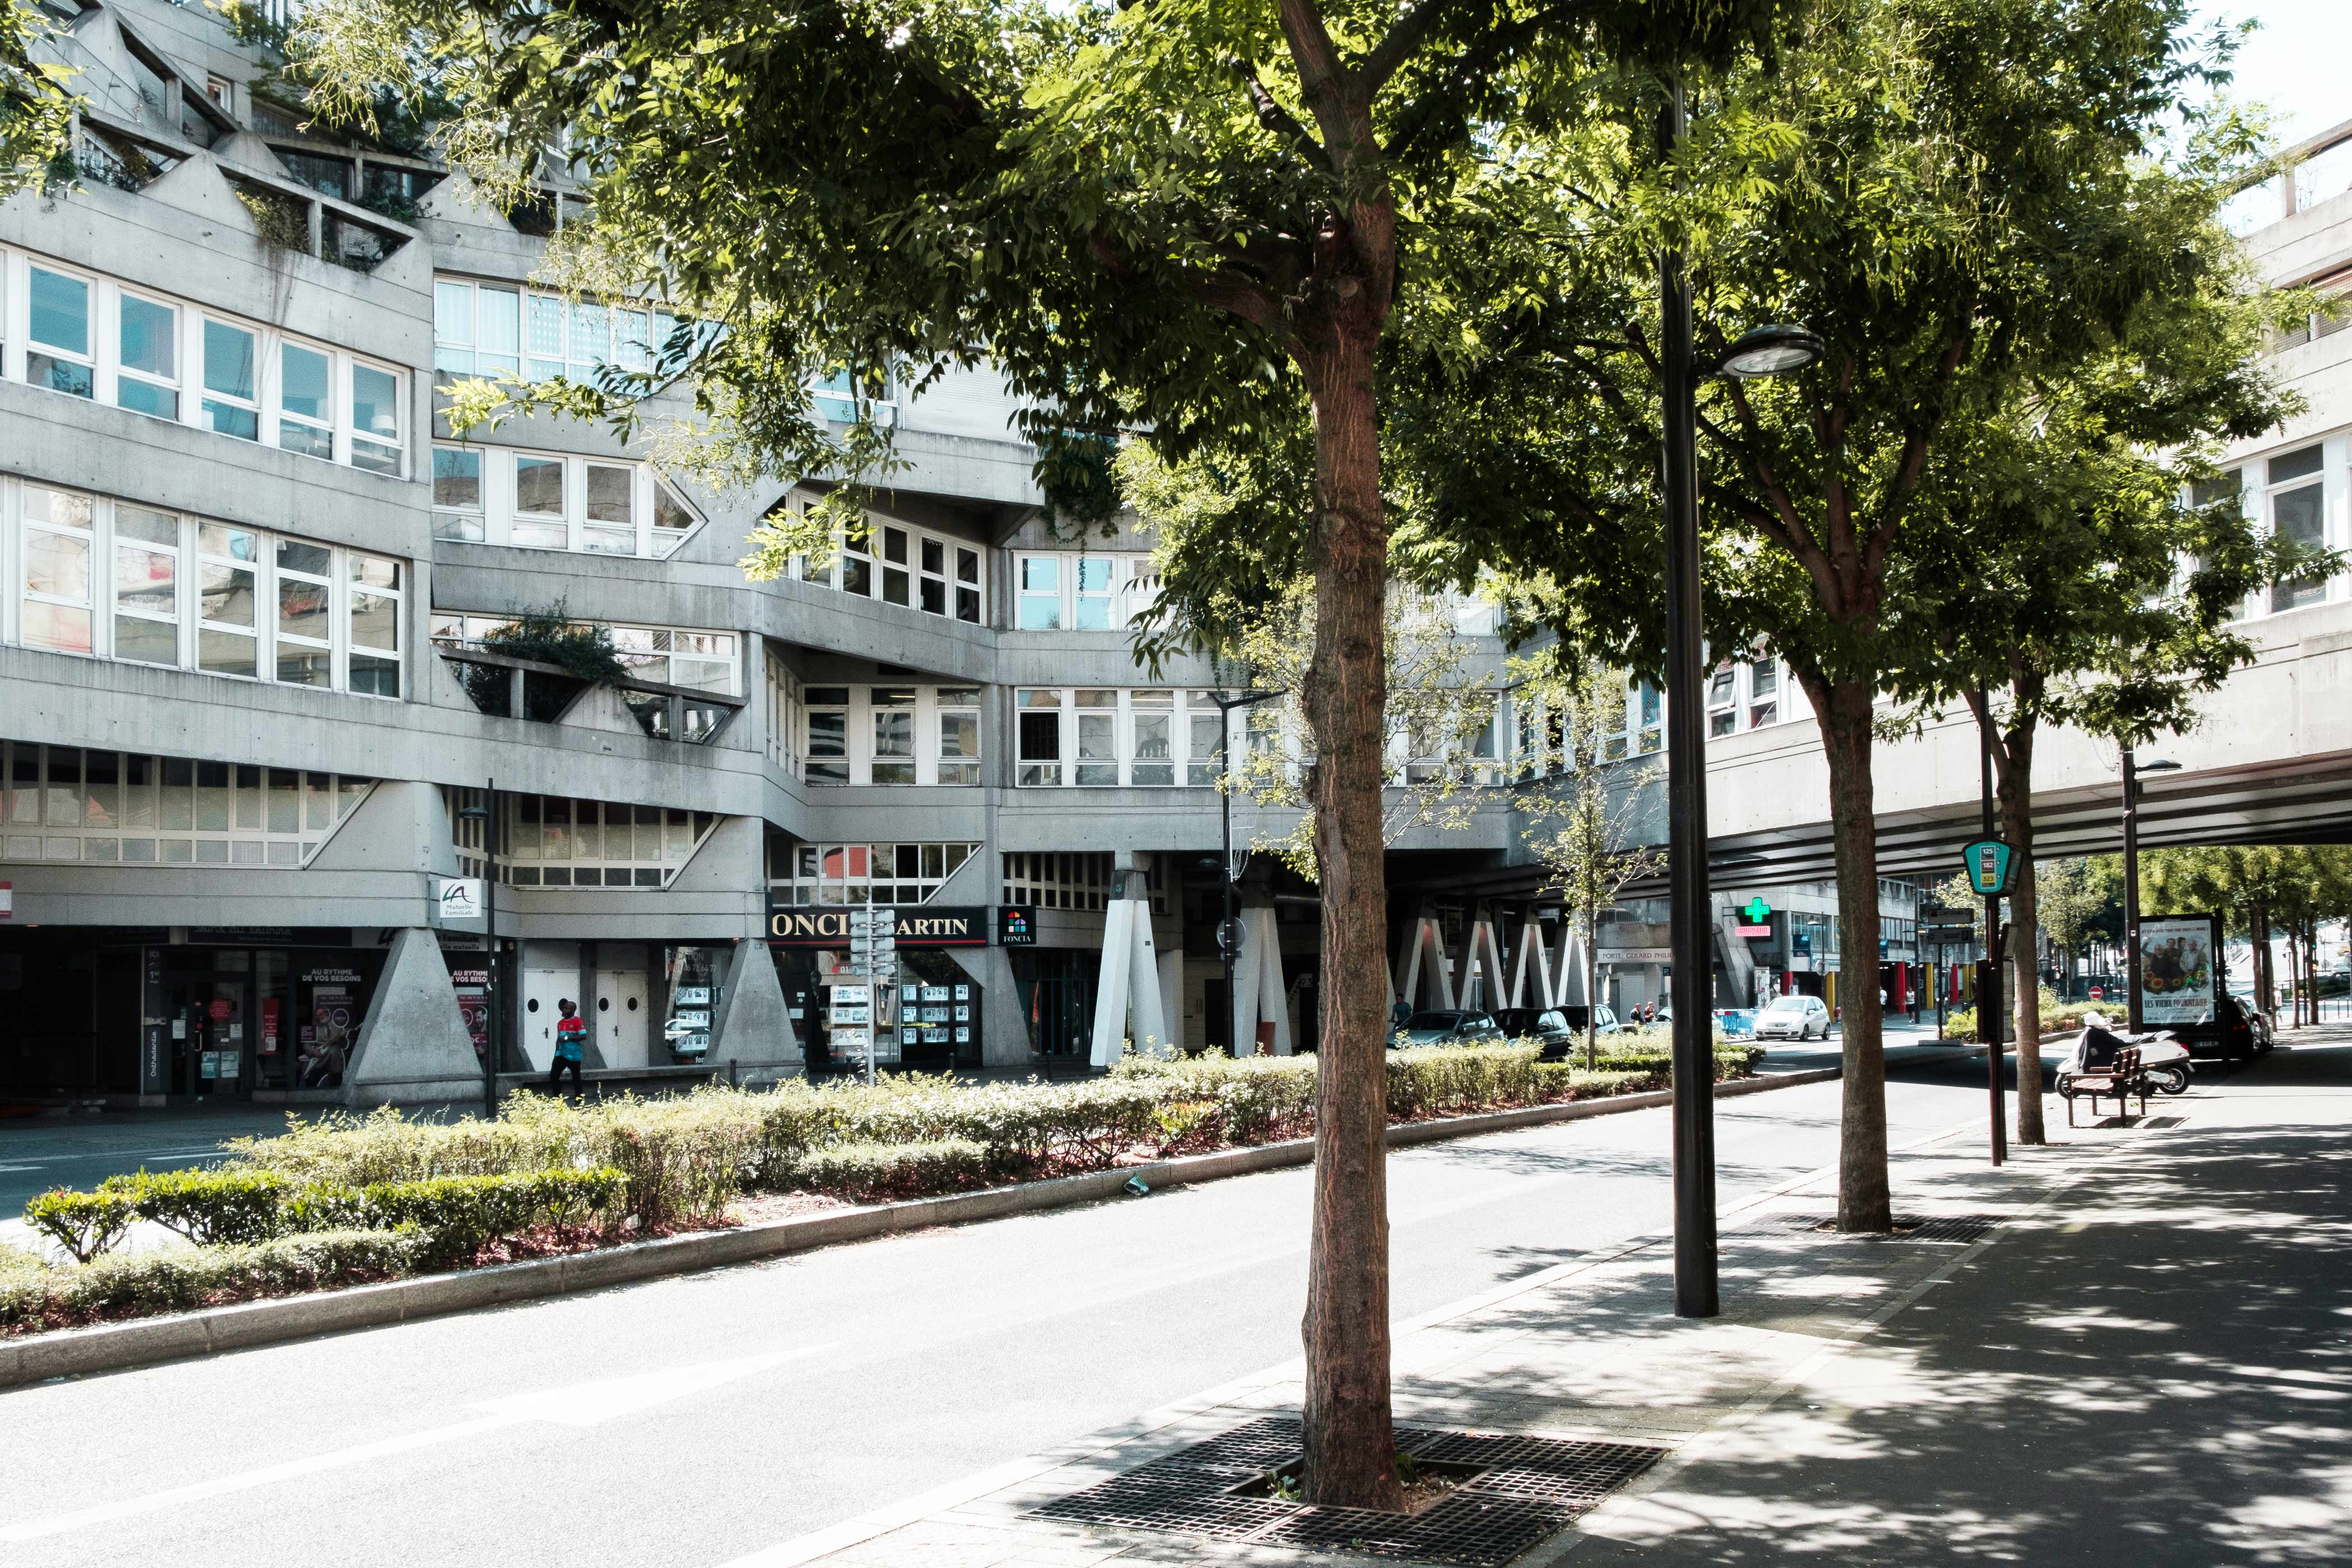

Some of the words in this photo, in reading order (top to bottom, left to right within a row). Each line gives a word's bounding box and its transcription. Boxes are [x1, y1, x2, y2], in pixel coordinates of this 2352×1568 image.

[772, 914, 851, 936] ONCI
[895, 919, 968, 935] ARTIN
[2144, 1000, 2154, 1008] LES
[2155, 999, 2172, 1007] VIEUX
